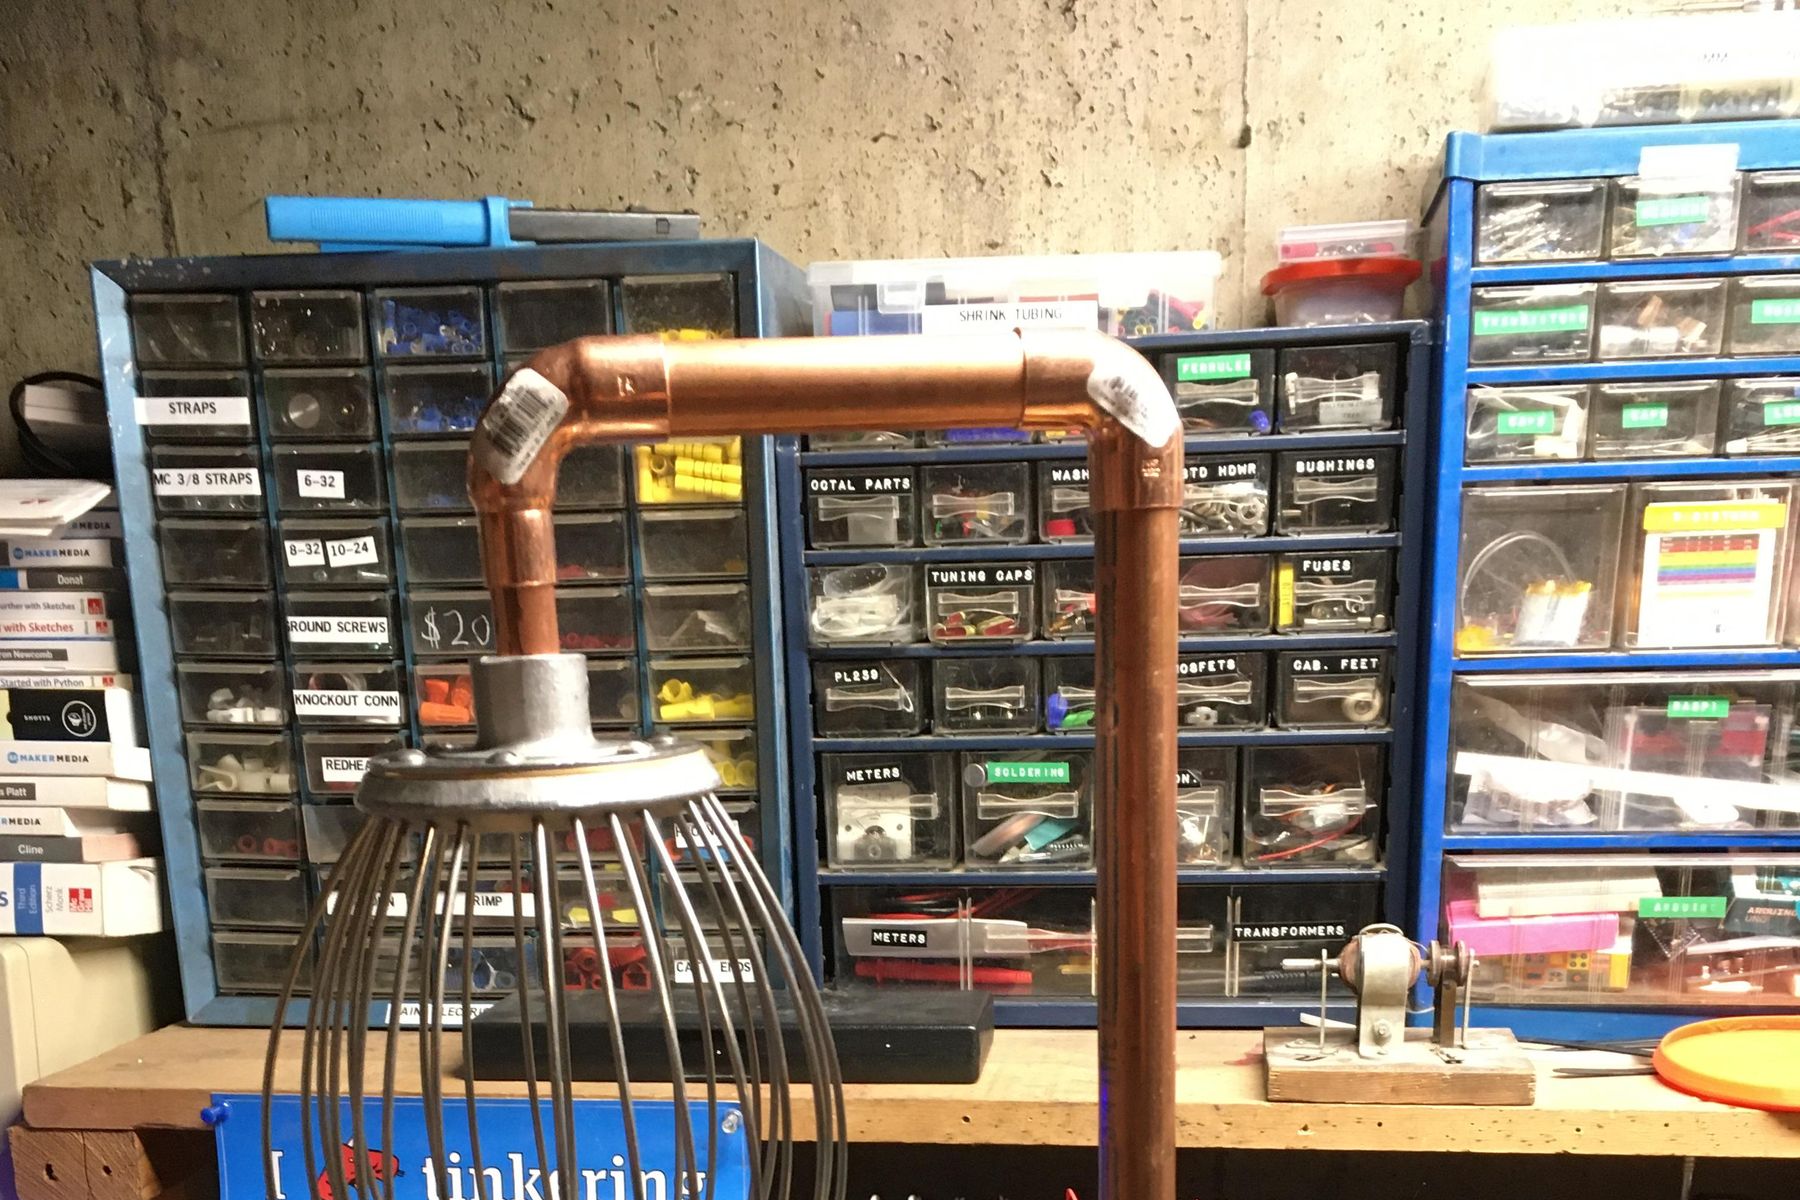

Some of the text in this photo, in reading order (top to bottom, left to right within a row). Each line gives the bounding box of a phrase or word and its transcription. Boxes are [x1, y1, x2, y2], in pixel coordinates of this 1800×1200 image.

[959, 307, 1063, 322] SHRINK TUBING
[168, 401, 217, 414] STRAPS
[1218, 463, 1257, 477] HDWR
[1296, 459, 1376, 474] BUSHINGS
[177, 472, 201, 485] 3/8
[206, 471, 253, 485] STRAPS
[304, 474, 336, 488] 6-32
[811, 477, 911, 492] OCTAL PARTS
[290, 543, 321, 556] 8-32
[331, 541, 370, 557] 10-24
[1303, 560, 1351, 573] FUSES
[57, 574, 84, 585] Donat
[931, 568, 1033, 583] TUNING CAPS
[4, 622, 74, 633] with Sketches
[337, 621, 387, 634] SCREWS
[421, 606, 491, 650] $20
[1177, 659, 1235, 674] OSFETS
[1341, 658, 1379, 670] FEET
[0, 678, 85, 690] Started with Python
[294, 694, 399, 707] KNOCKOUT CONN
[846, 767, 900, 782] METERS
[6, 786, 27, 797] Platt
[18, 844, 44, 855] Cline
[473, 896, 503, 906] RIMP
[873, 931, 926, 944] METERS
[1235, 925, 1344, 938] TRANSFORMERS
